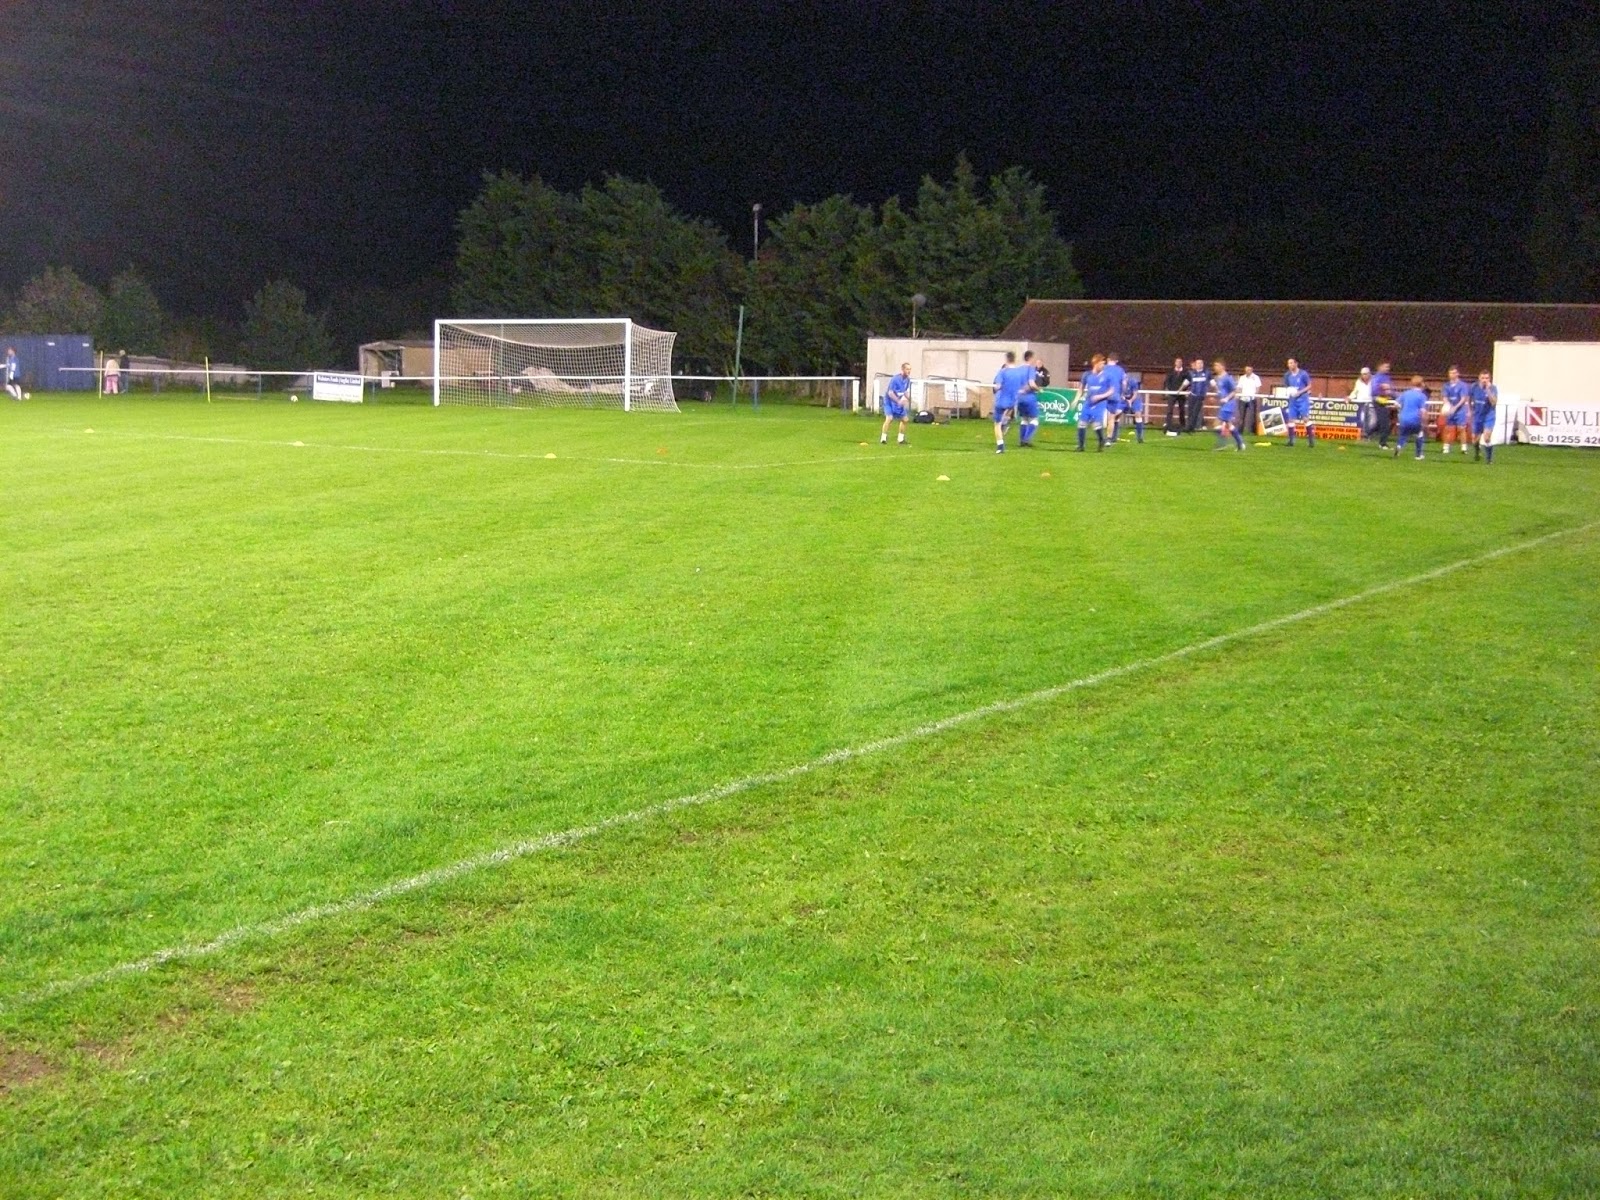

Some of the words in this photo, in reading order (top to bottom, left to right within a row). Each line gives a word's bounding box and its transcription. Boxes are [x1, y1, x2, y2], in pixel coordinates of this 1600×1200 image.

[1262, 398, 1289, 408] Pump
[1326, 401, 1359, 411] Centre
[1547, 434, 1581, 444] 01255
